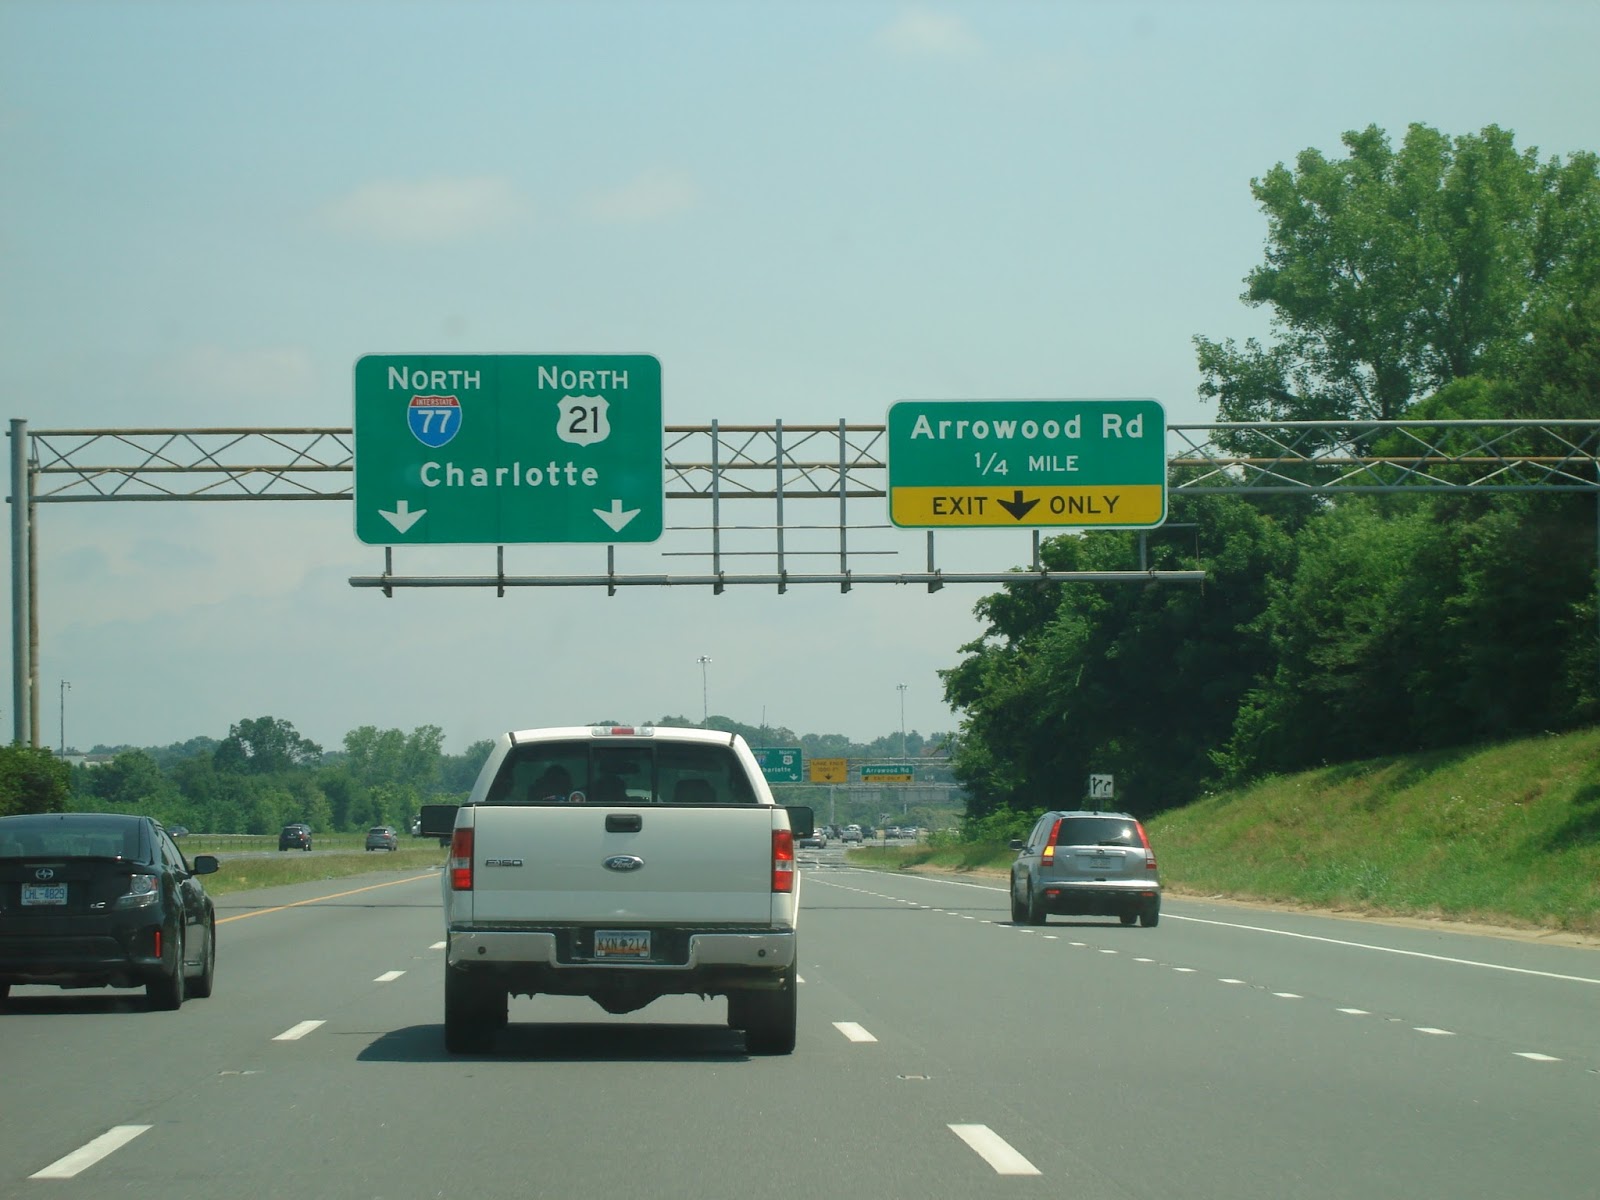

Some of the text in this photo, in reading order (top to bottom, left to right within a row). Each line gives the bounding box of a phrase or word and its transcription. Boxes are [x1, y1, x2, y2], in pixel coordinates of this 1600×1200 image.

[388, 366, 481, 390] NORTH
[538, 366, 629, 390] NORTH
[416, 398, 453, 406] INTERSTATE
[417, 409, 452, 434] 77
[568, 405, 599, 433] 21
[910, 413, 1143, 440] Arrowood Rd
[420, 461, 599, 487] Charlotte
[974, 452, 1079, 476] 1/4 MILE
[932, 495, 1120, 515] EXIT ONLY
[611, 858, 634, 869] Ford
